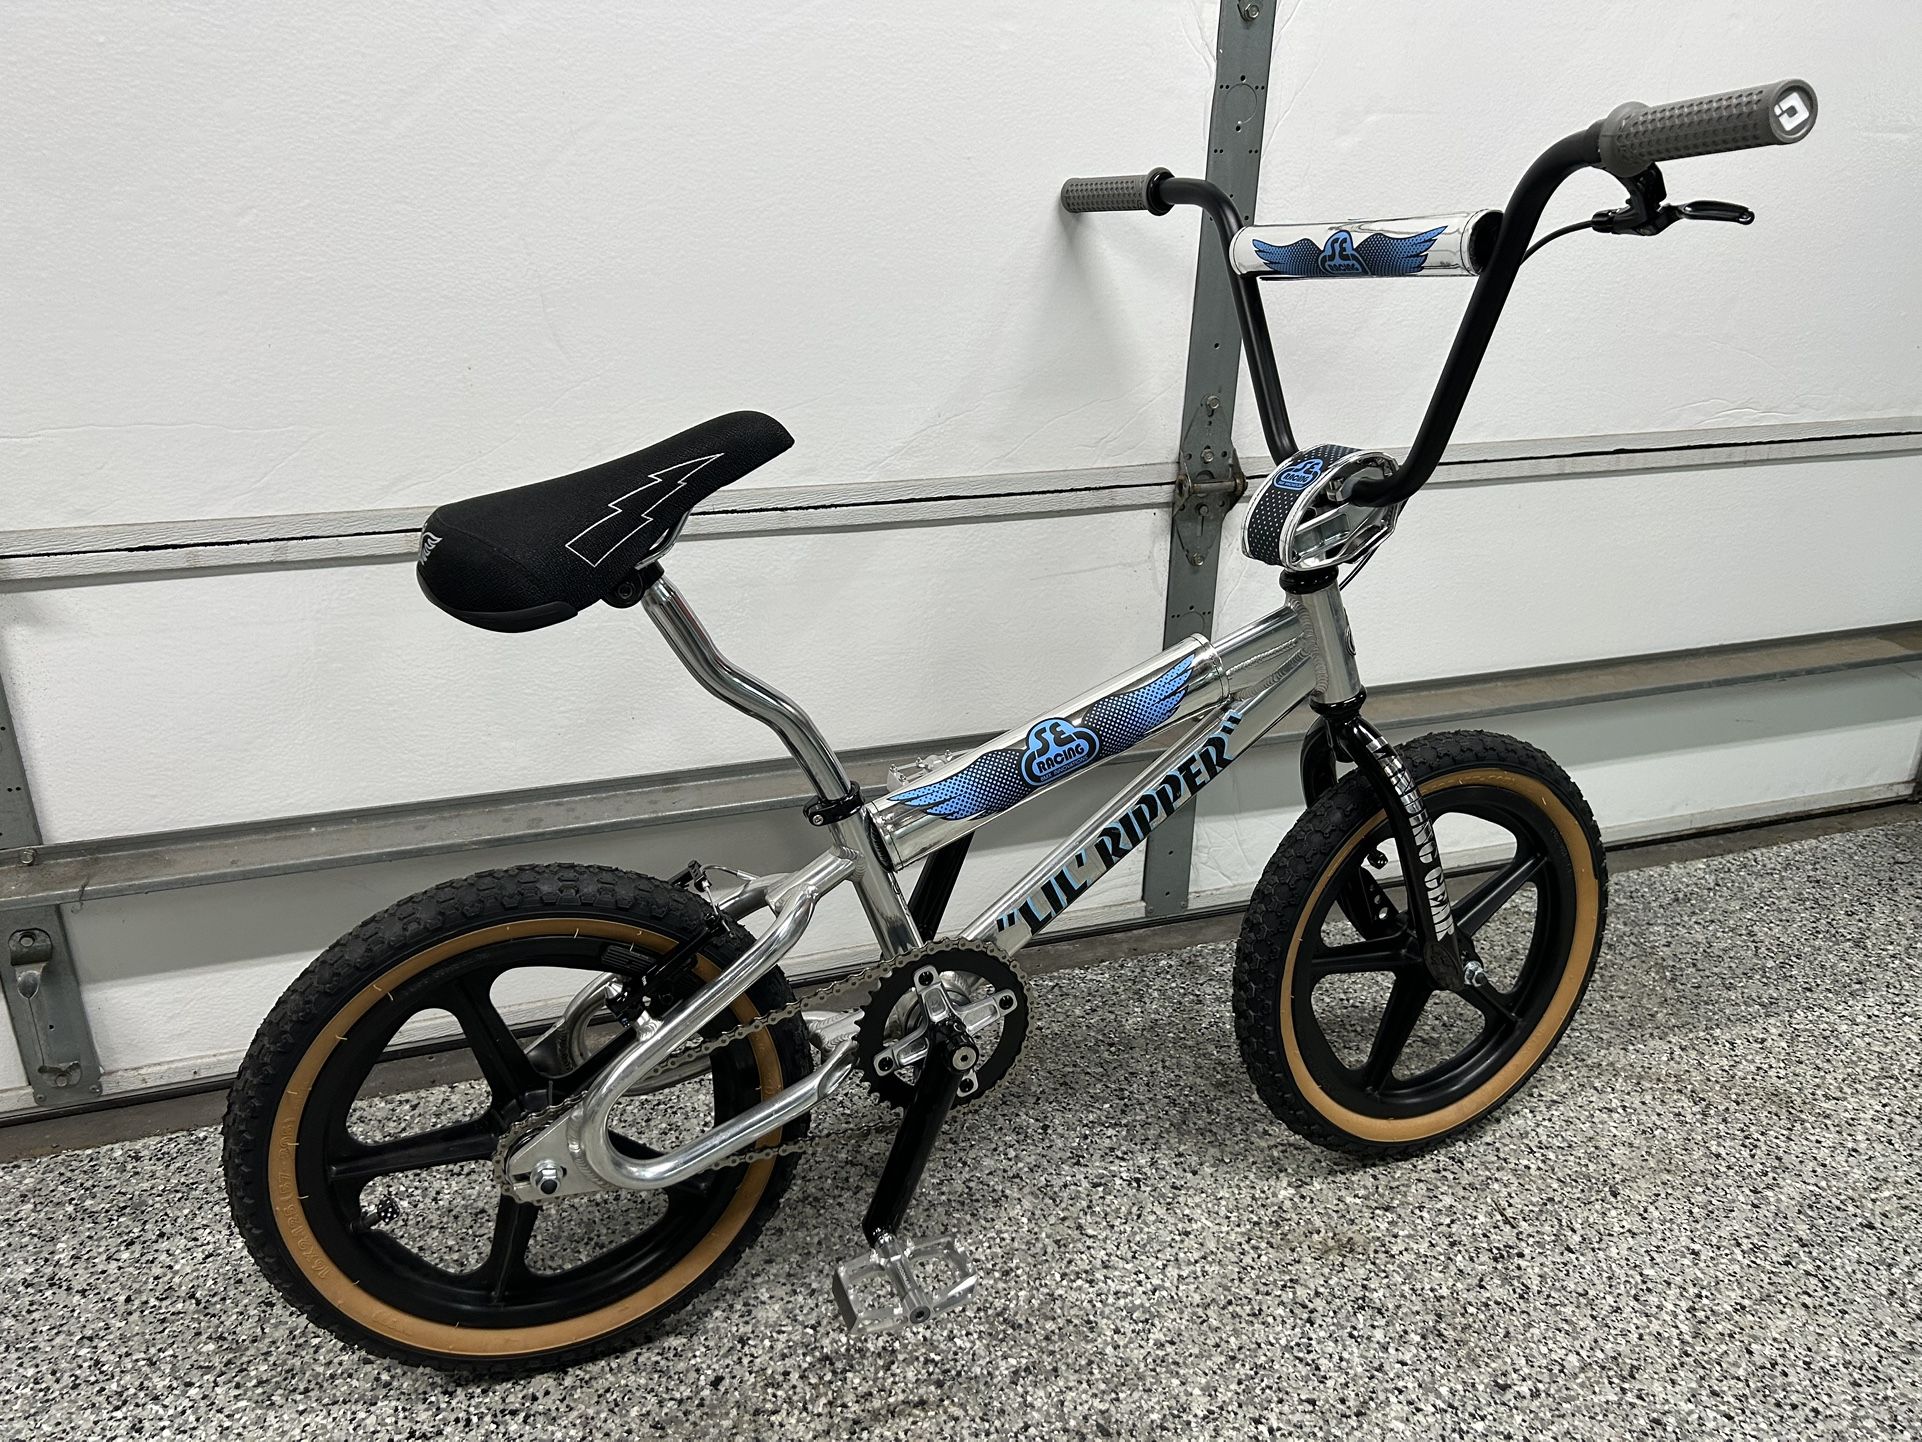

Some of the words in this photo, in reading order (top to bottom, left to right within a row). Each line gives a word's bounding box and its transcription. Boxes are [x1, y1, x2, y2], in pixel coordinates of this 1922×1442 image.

[1328, 237, 1351, 261] SE
[1293, 461, 1320, 474] SE
[1034, 722, 1077, 758] SE
[1036, 743, 1085, 773] RACING
[1366, 736, 1438, 864] LANDING
[1424, 866, 1455, 941] GEAR
